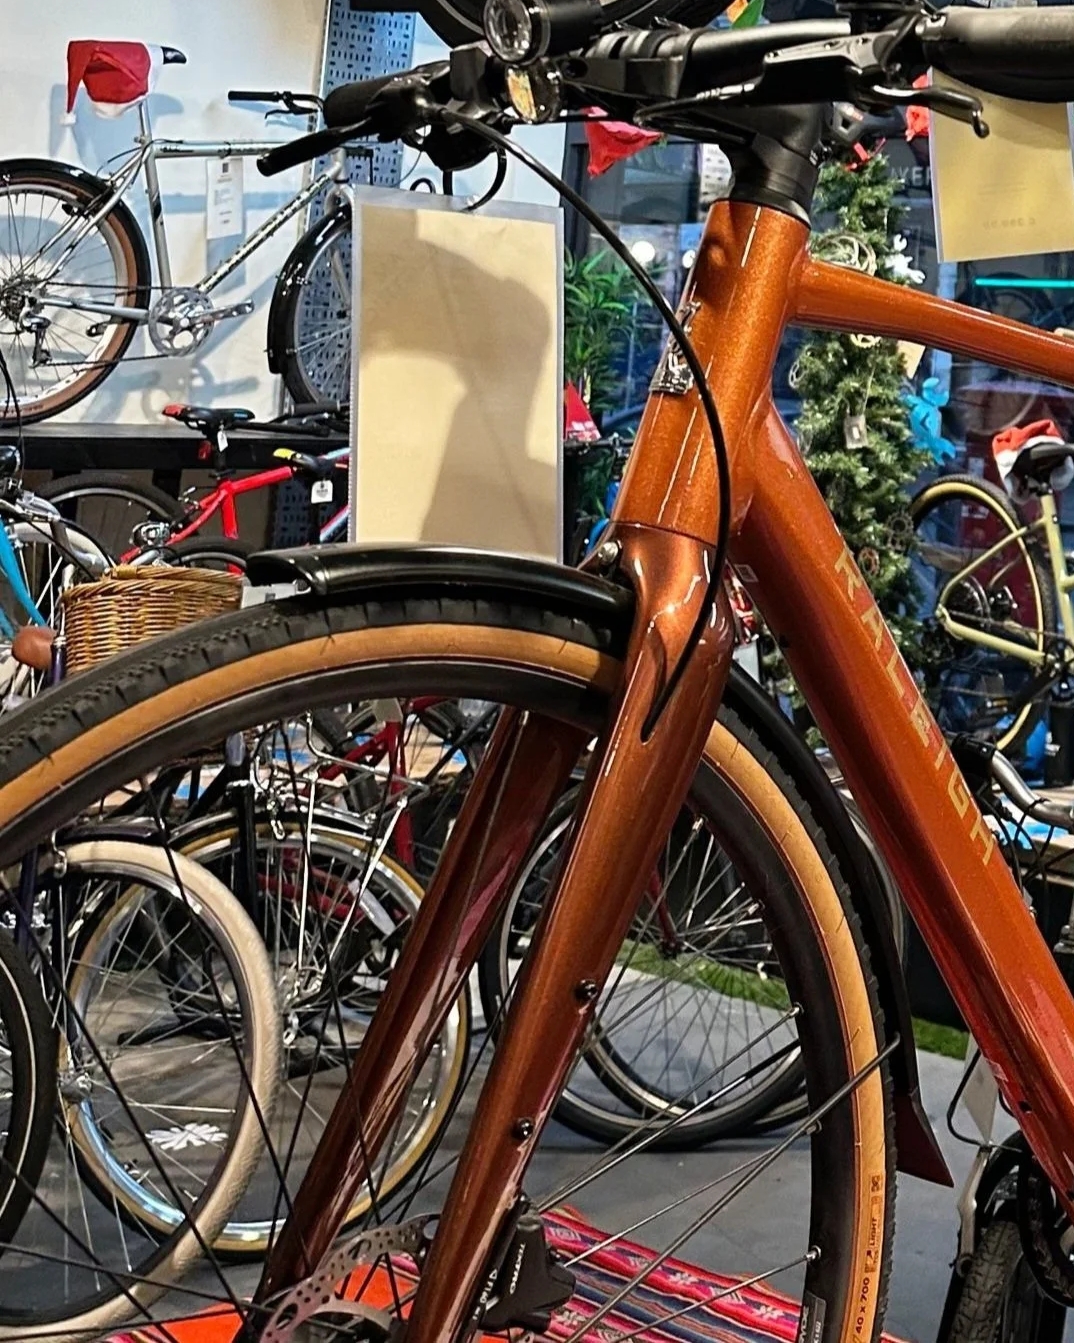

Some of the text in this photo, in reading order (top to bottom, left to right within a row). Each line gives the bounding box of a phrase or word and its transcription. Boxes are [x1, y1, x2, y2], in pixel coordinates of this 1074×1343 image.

[834, 545, 995, 866] RALEIGH
[870, 1218, 878, 1246] LIGHT
[510, 1243, 525, 1295] TEKTRO
[855, 1317, 864, 1333] 40
[860, 1277, 870, 1302] 700
